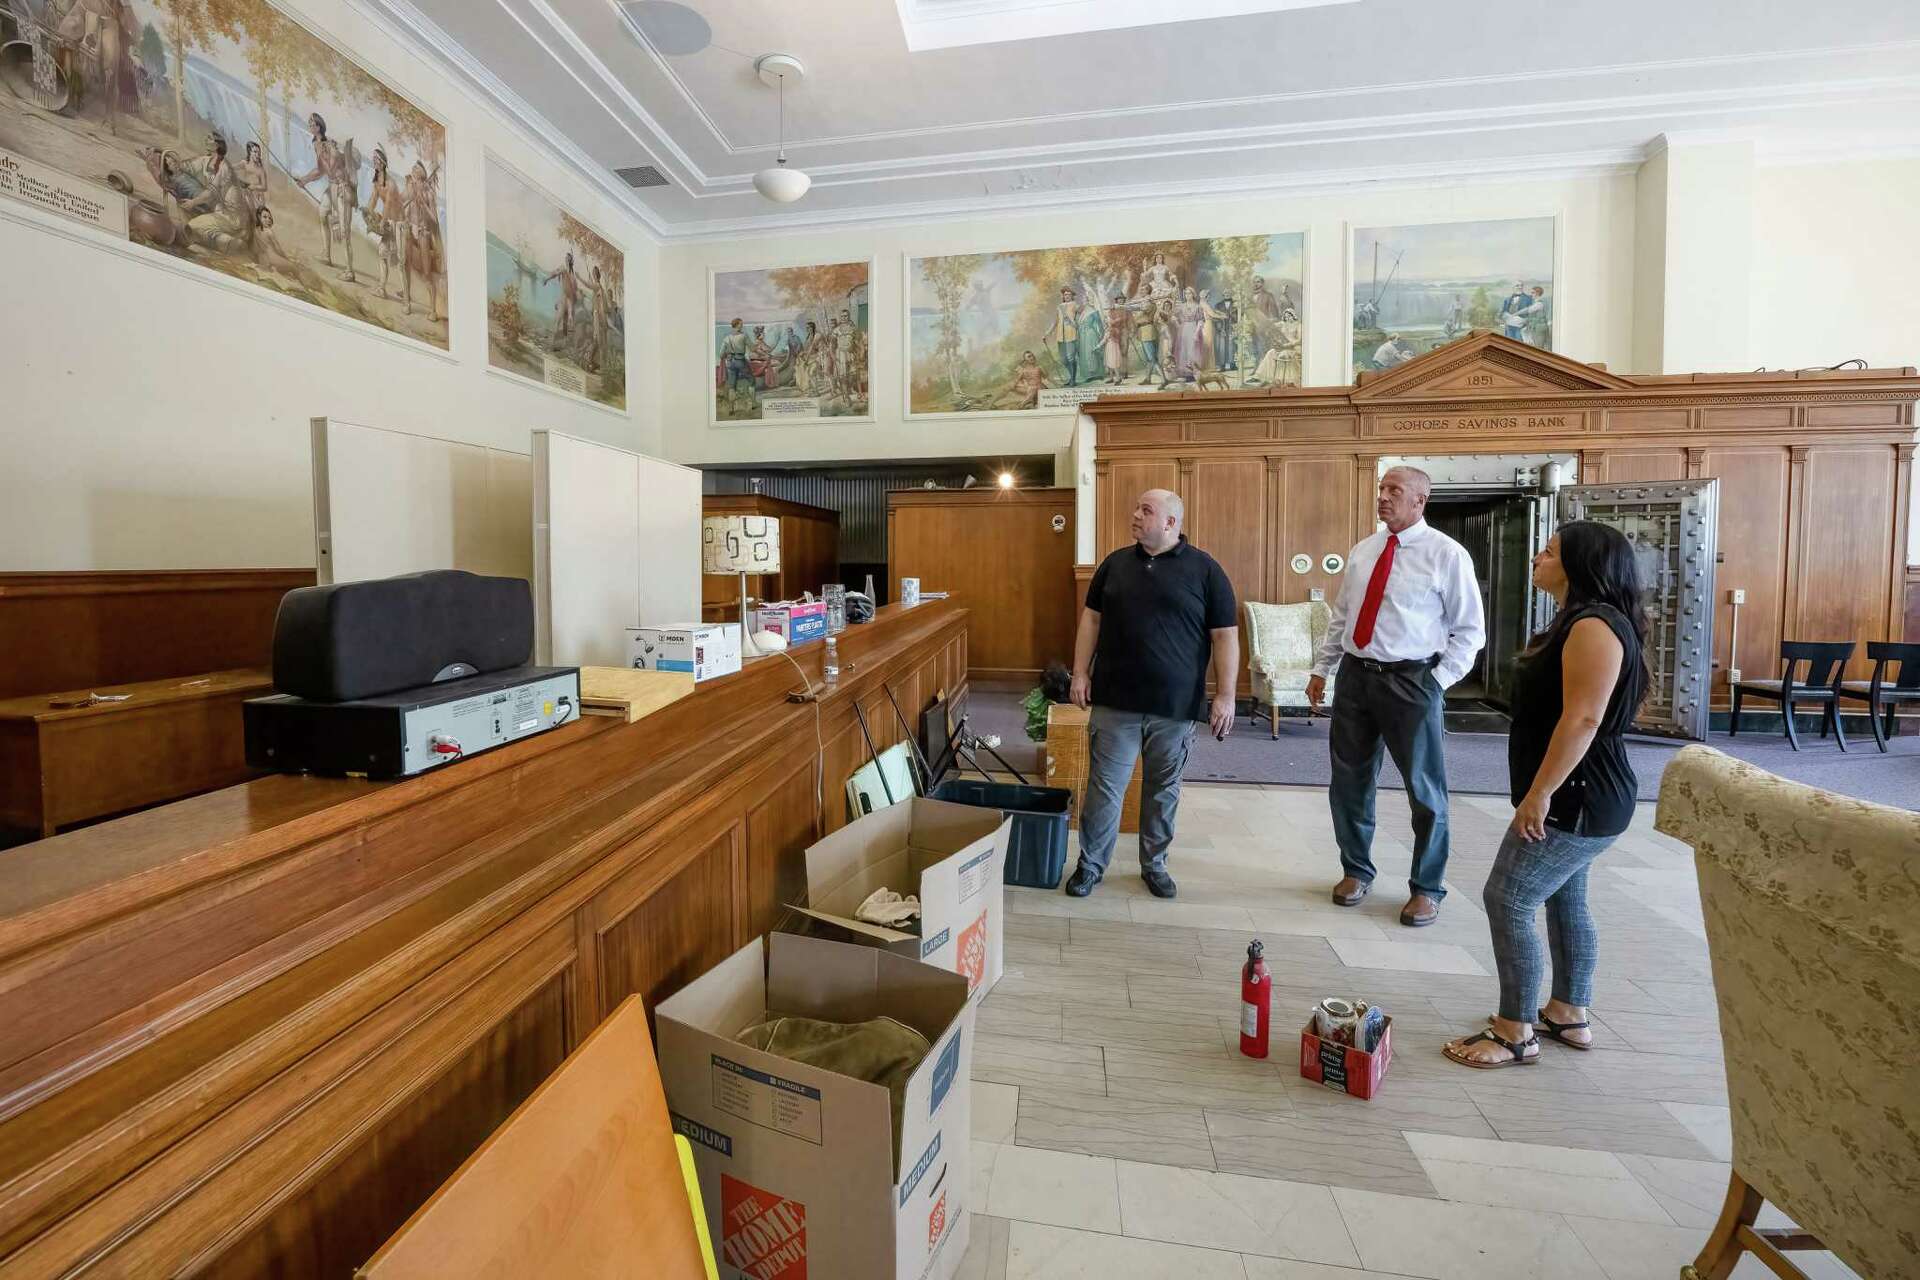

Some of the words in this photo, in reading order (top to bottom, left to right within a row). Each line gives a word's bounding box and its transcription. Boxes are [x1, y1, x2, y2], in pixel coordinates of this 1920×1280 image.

[1466, 375, 1494, 386] 1851
[1393, 419, 1449, 431] COHOES
[1457, 417, 1517, 430] SAVINGS
[1528, 416, 1567, 428] BANK
[924, 930, 948, 955] LARGE
[778, 1080, 805, 1093] FRAGILE
[903, 1139, 939, 1199] MEDIUM
[729, 1196, 763, 1226] THE
[724, 1199, 806, 1269] HOME
[755, 1238, 806, 1280] DEPOT
